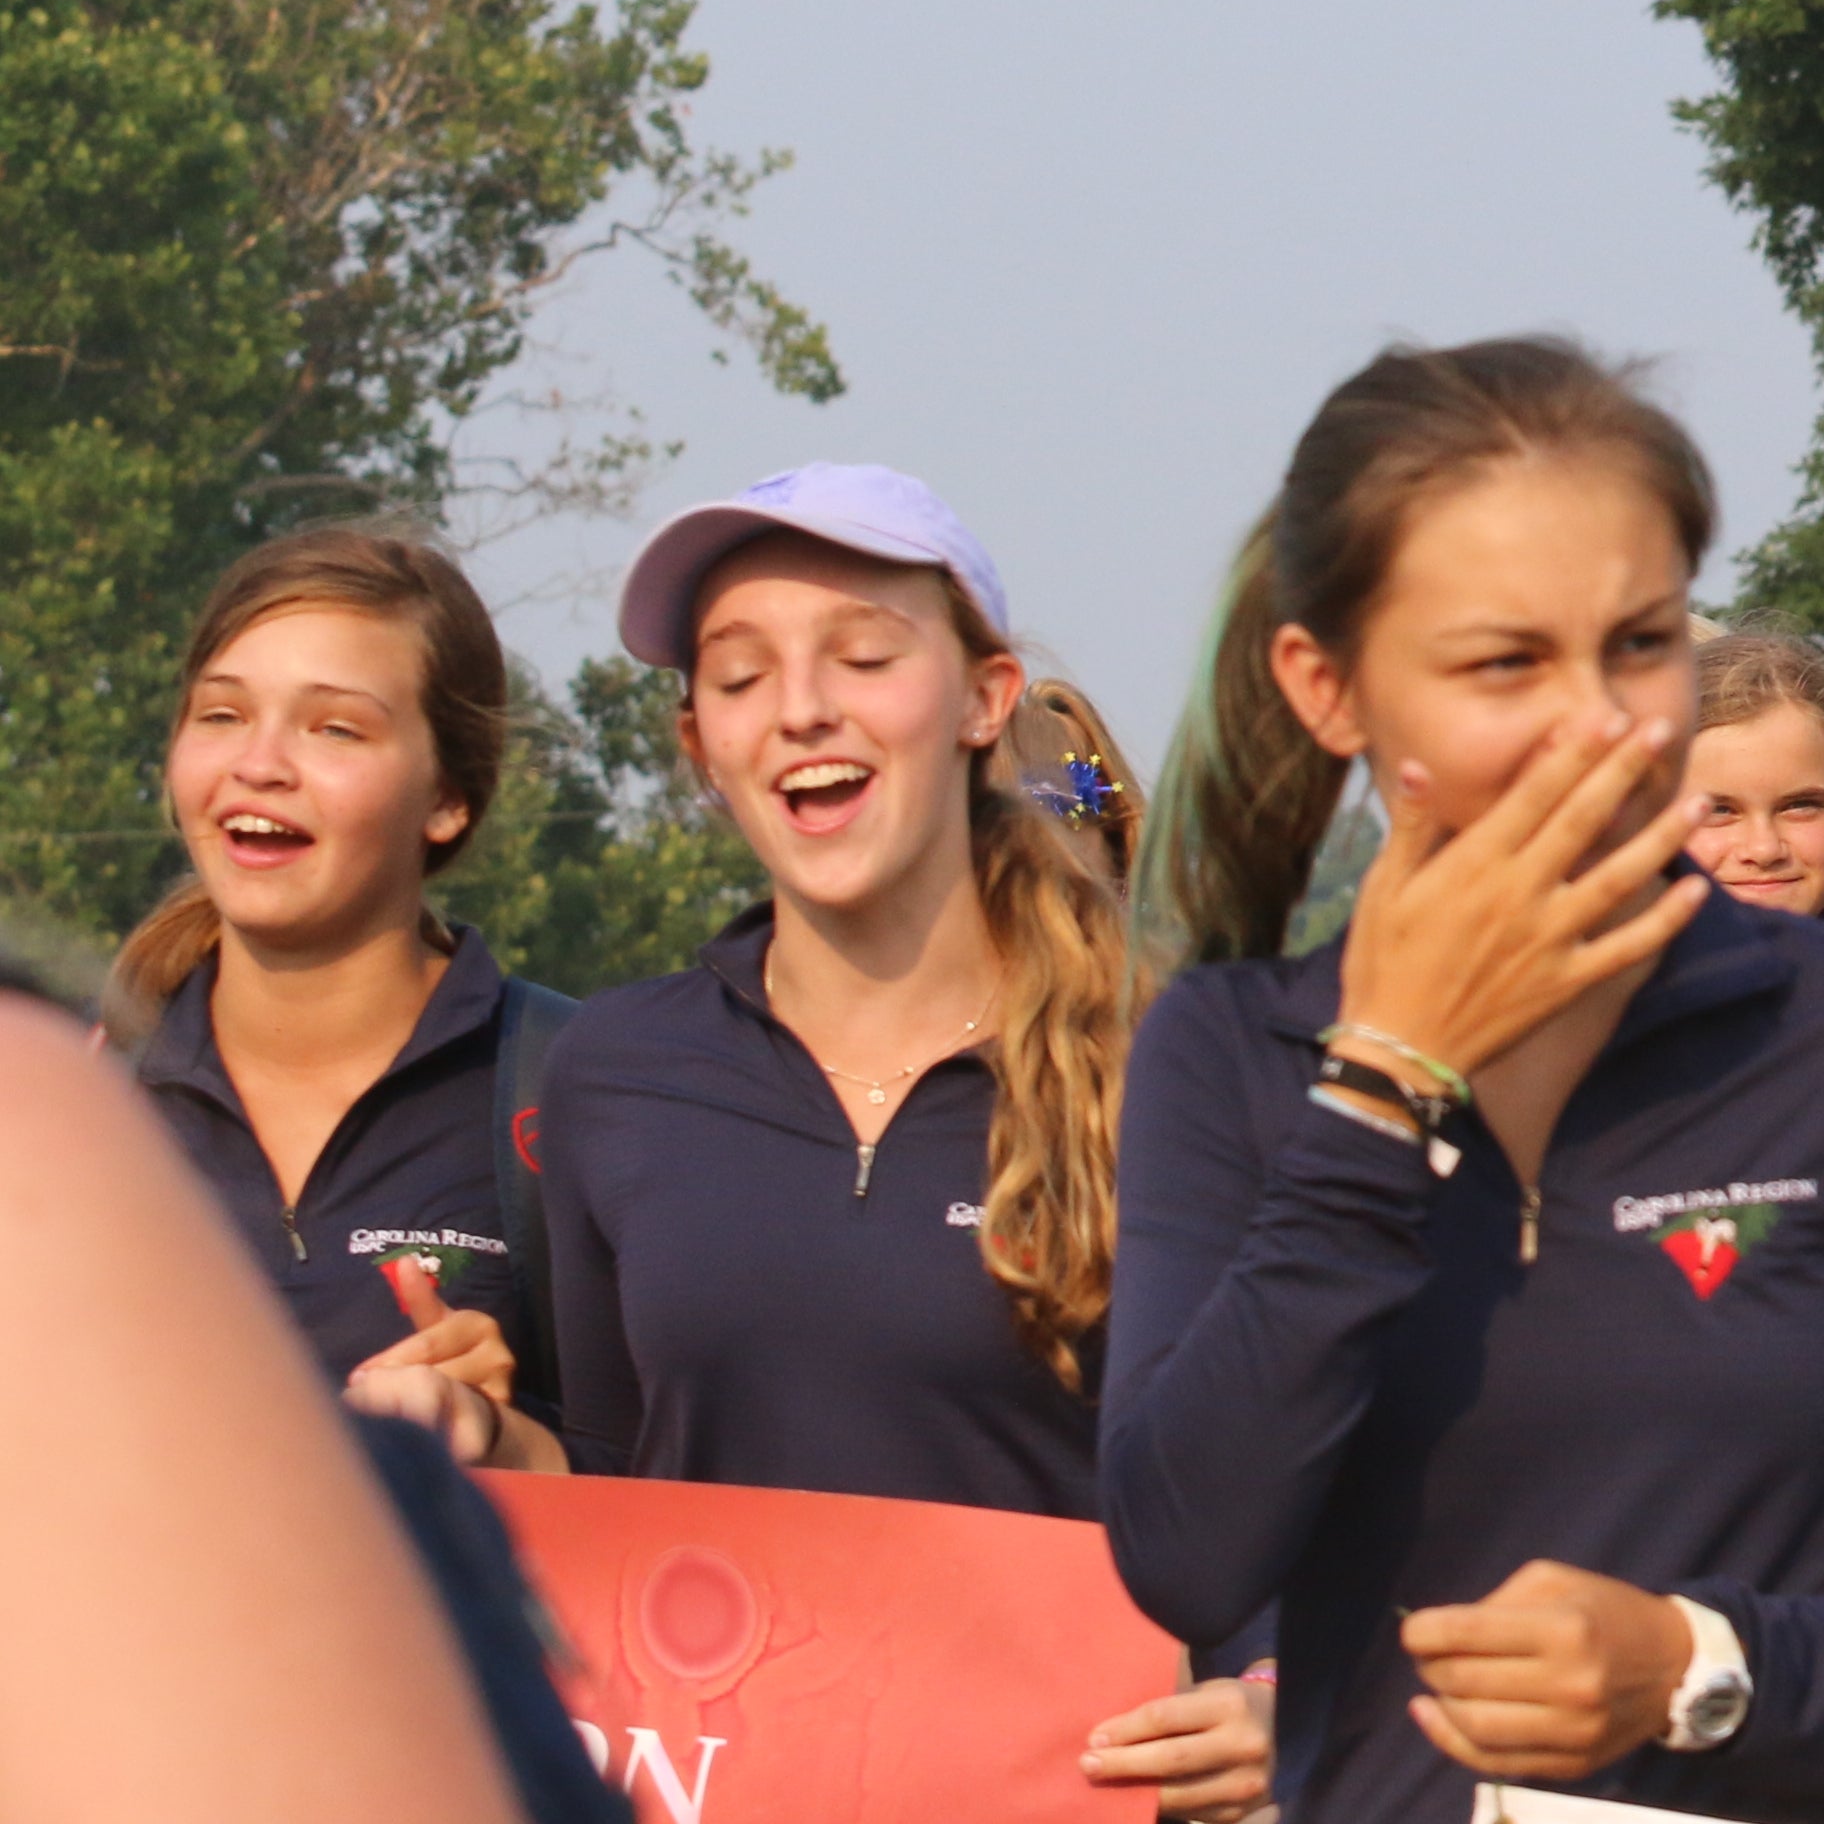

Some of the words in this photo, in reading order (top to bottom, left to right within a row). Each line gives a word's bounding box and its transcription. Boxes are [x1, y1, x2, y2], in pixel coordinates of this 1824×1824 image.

[1613, 1188, 1729, 1215] CAROLINA
[1727, 1178, 1819, 1205] REGION
[350, 1228, 441, 1246] CAROLINA
[441, 1228, 509, 1254] REGION
